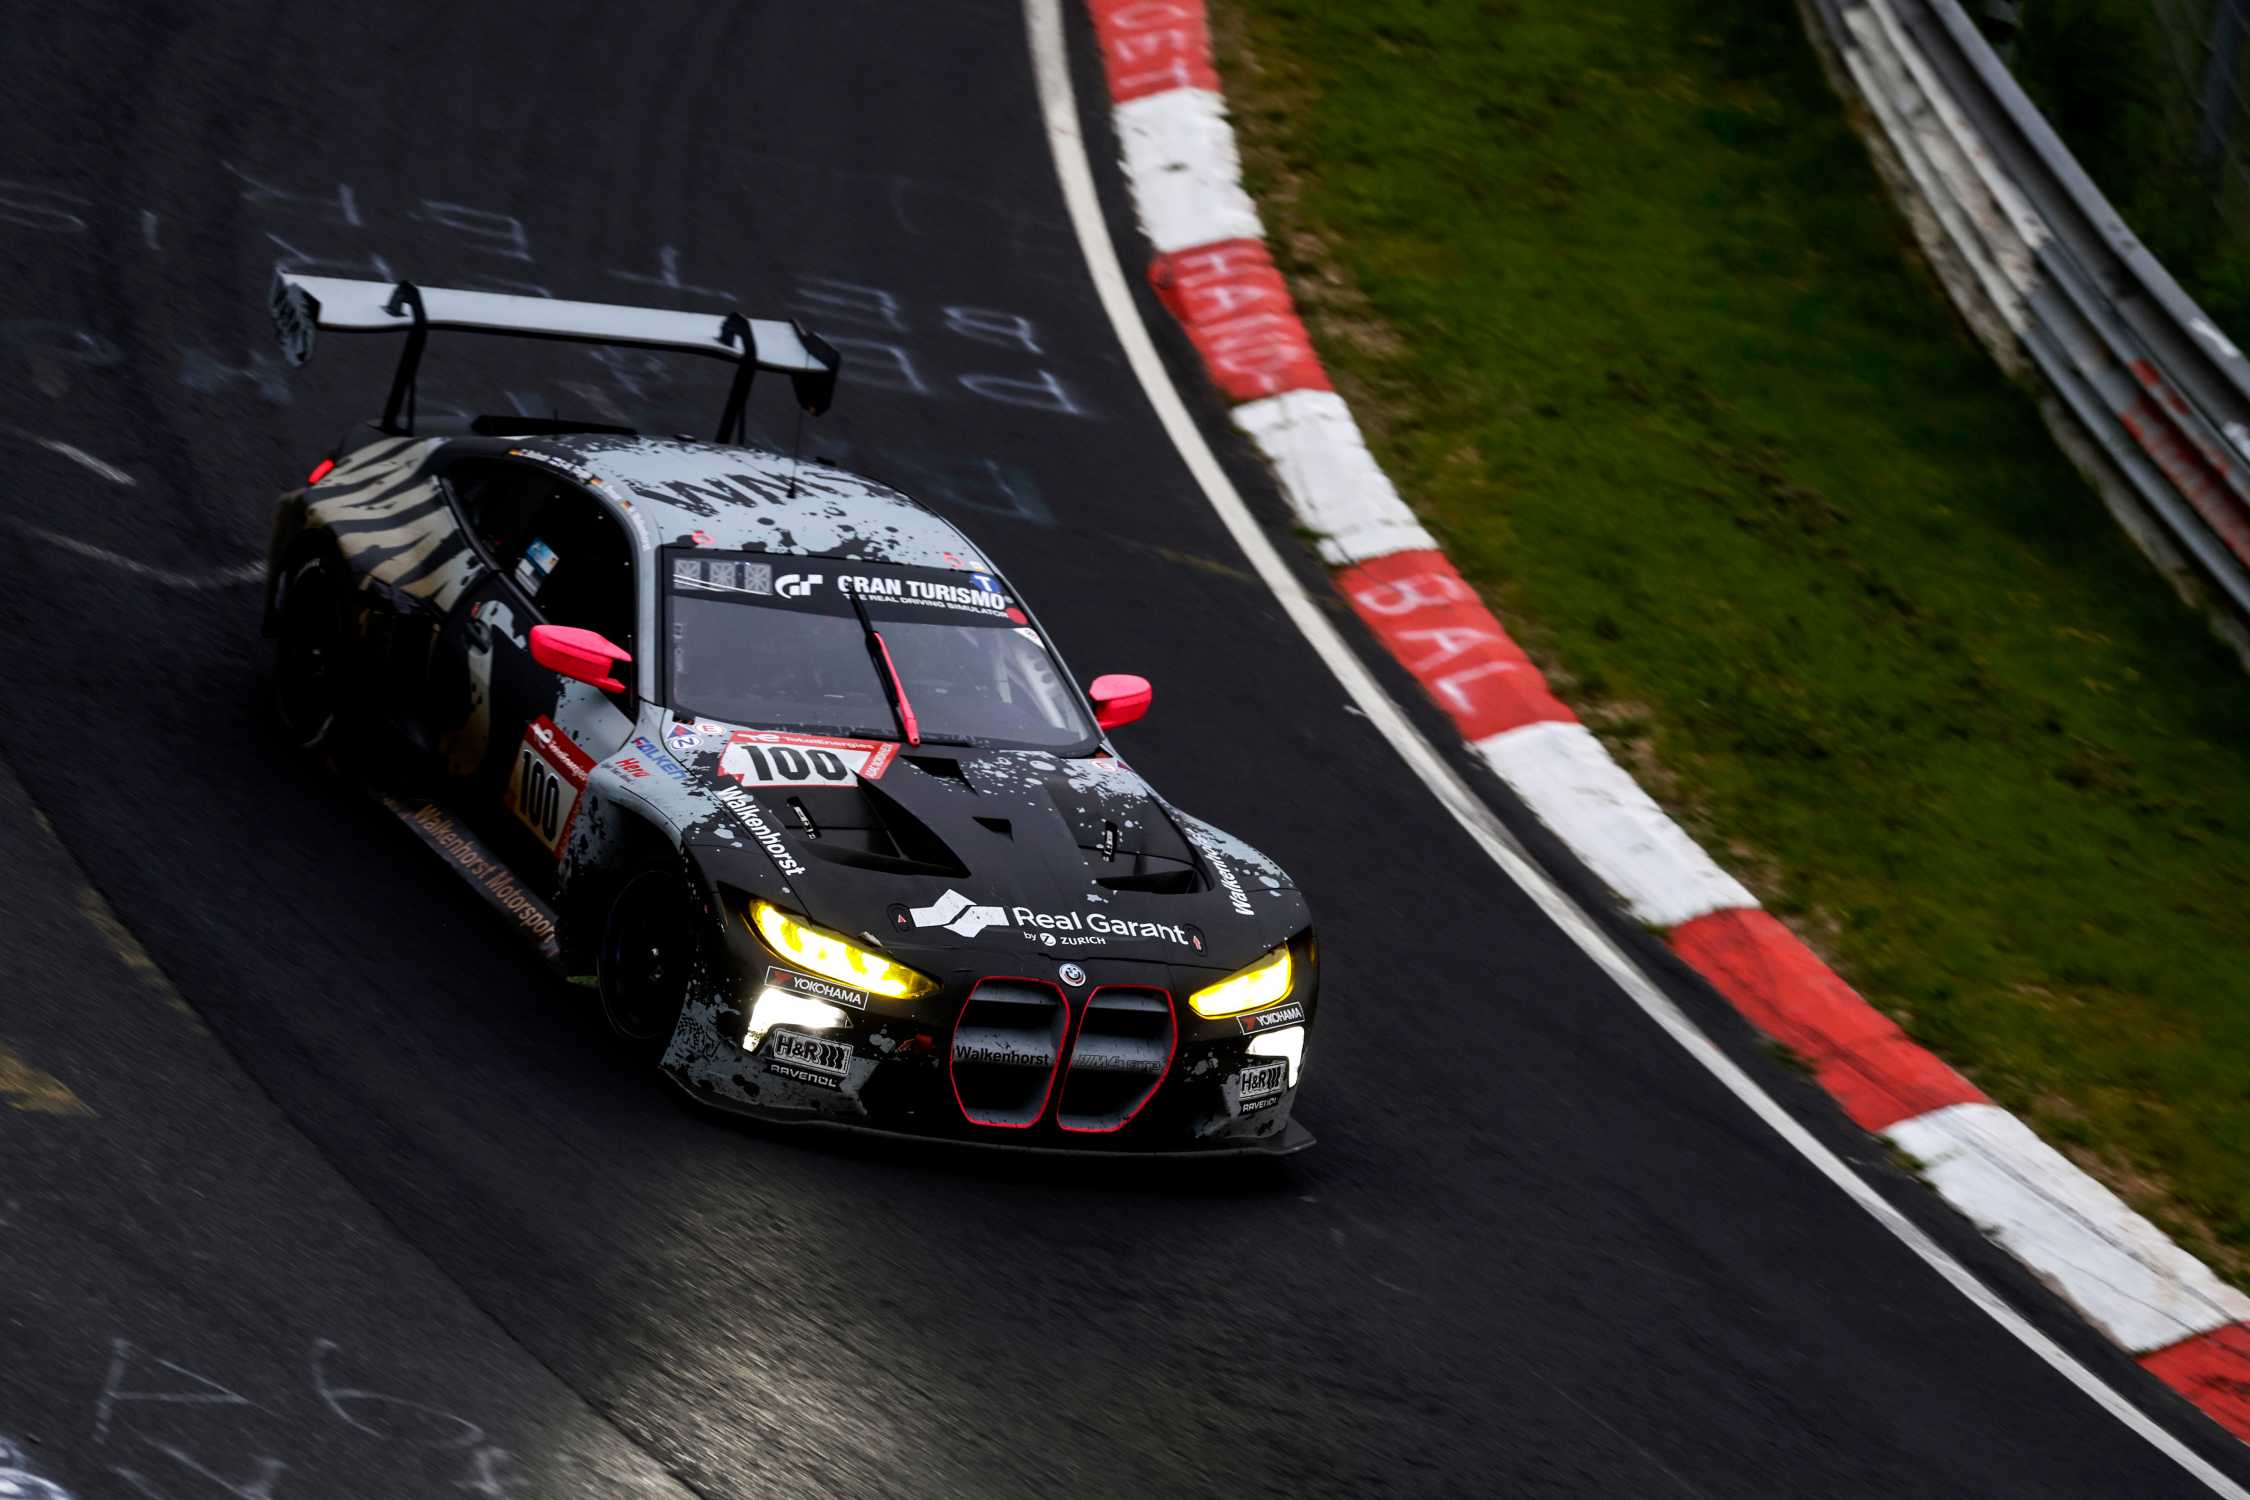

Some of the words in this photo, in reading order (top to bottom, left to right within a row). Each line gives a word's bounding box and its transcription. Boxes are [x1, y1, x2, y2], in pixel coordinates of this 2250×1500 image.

[837, 574, 902, 596] GRAN
[843, 592, 867, 602] TE
[868, 593, 899, 604] REAL
[901, 597, 945, 609] DRIVING
[1355, 572, 1518, 716] BAL
[742, 744, 848, 782] 100
[520, 750, 560, 842] 100
[717, 785, 807, 876] Walkenhorst
[1012, 906, 1082, 931] Real
[1086, 912, 1190, 946] Garant
[1023, 931, 1037, 942] by
[1061, 935, 1107, 946] ZURICH
[793, 976, 863, 1006] YOKOHAMA
[1256, 1007, 1302, 1027] YOKOHAMA
[776, 1034, 820, 1063] H&R
[956, 1044, 1050, 1067] Walkenhorst
[770, 1064, 839, 1088] RAVENOL
